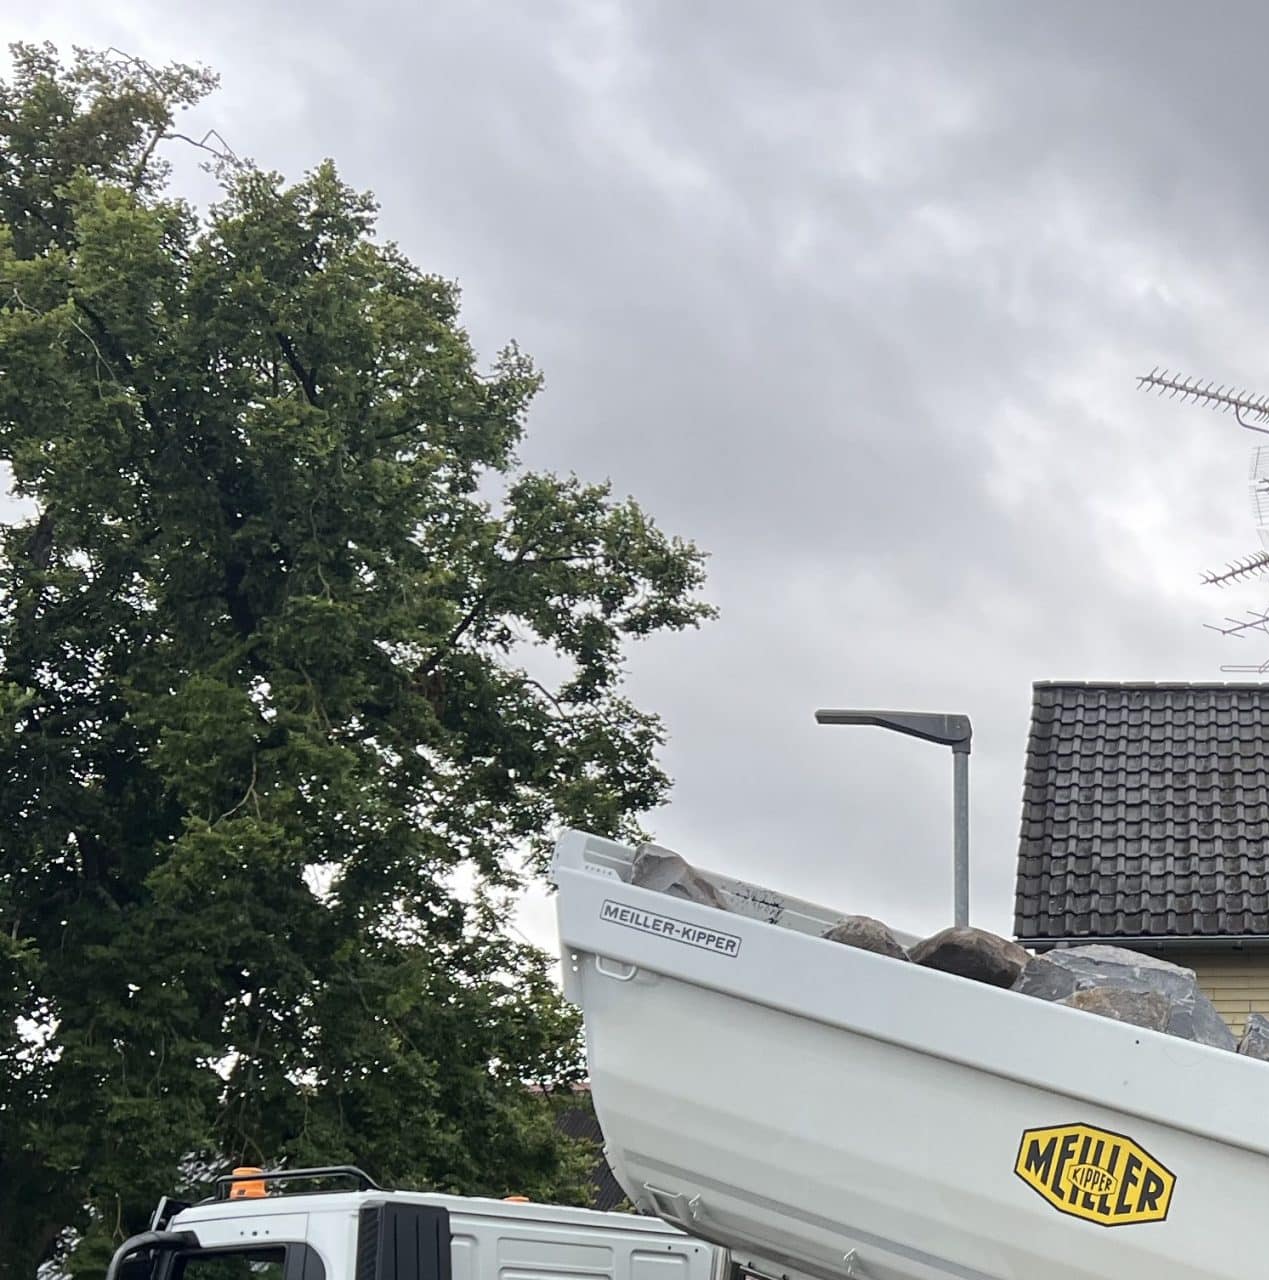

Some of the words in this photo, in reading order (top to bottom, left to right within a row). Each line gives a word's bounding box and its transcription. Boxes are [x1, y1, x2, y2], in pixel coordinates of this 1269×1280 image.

[603, 904, 737, 953] MEILLER-KIPPER
[1024, 1133, 1166, 1216] MEILLER
[1072, 1167, 1114, 1192] KIPPER
